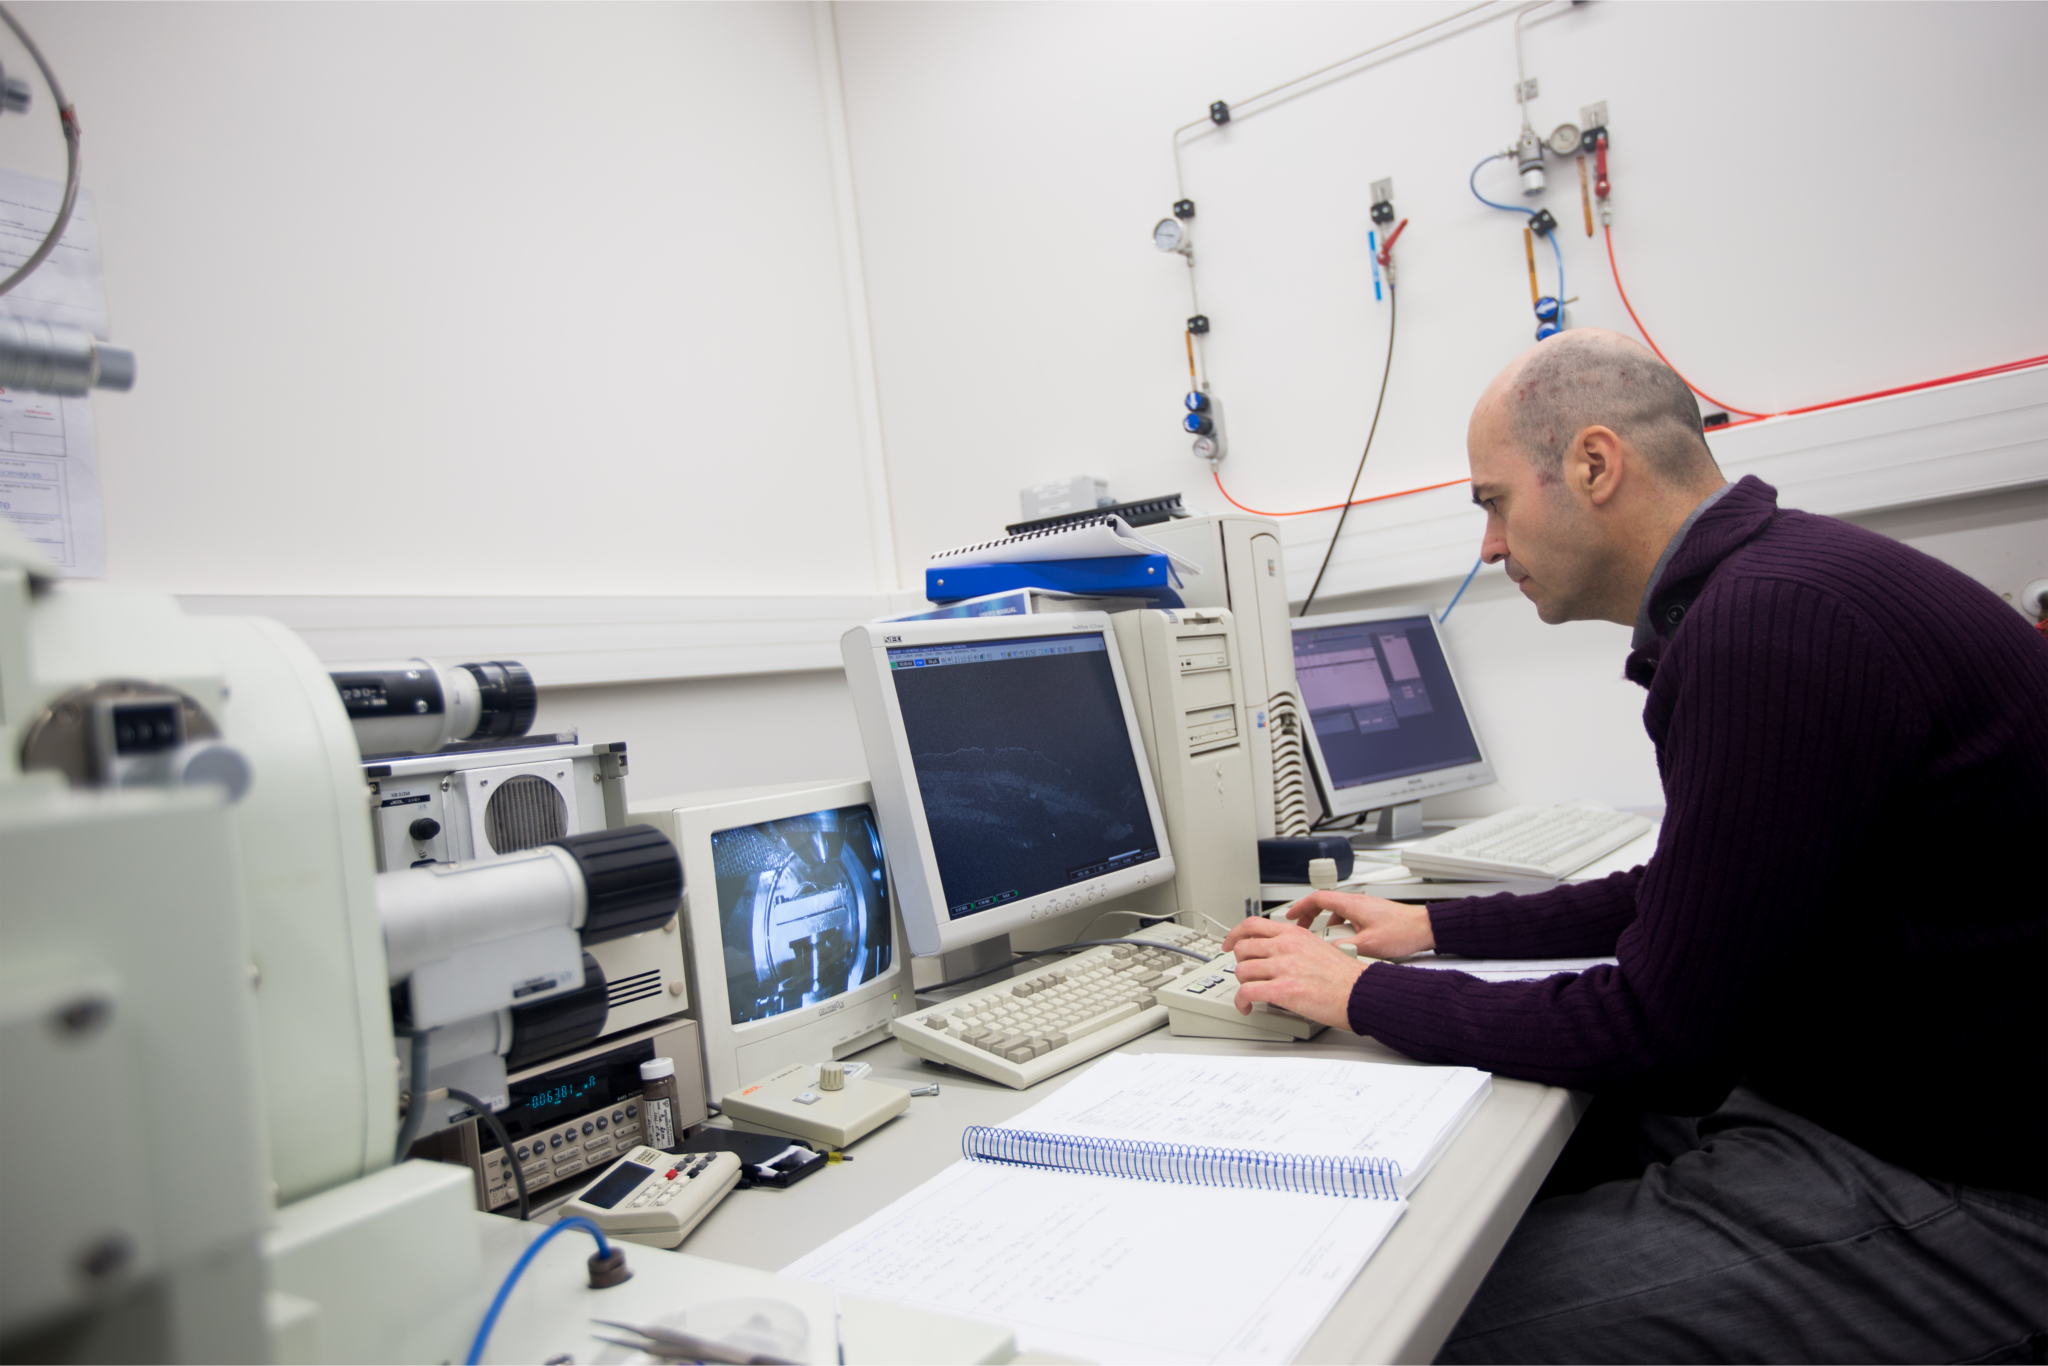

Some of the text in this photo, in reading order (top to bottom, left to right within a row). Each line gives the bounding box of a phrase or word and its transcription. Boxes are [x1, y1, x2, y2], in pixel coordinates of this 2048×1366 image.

[996, 606, 1018, 616] MANUAL
[883, 635, 903, 643] NEC
[489, 1183, 507, 1193] POWER
